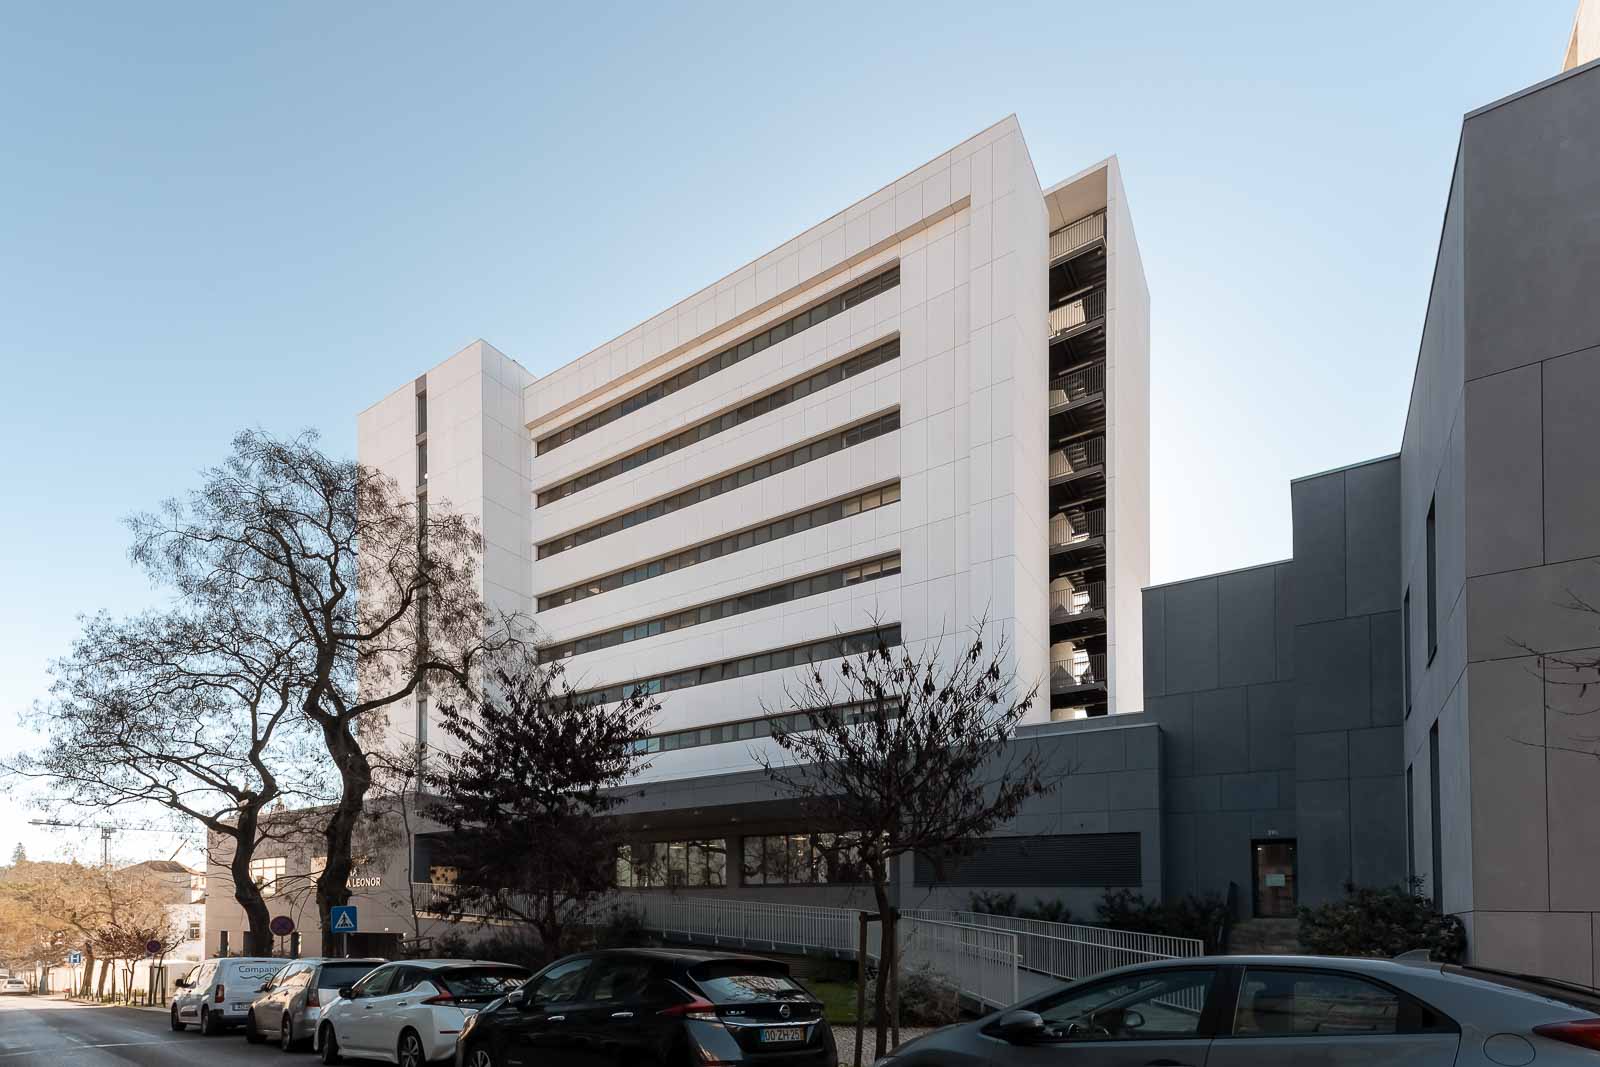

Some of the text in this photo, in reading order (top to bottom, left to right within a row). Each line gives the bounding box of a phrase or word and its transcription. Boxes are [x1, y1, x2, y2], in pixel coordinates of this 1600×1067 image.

[352, 877, 381, 888] LEONOR
[70, 954, 80, 963] H
[239, 965, 281, 974] Companh
